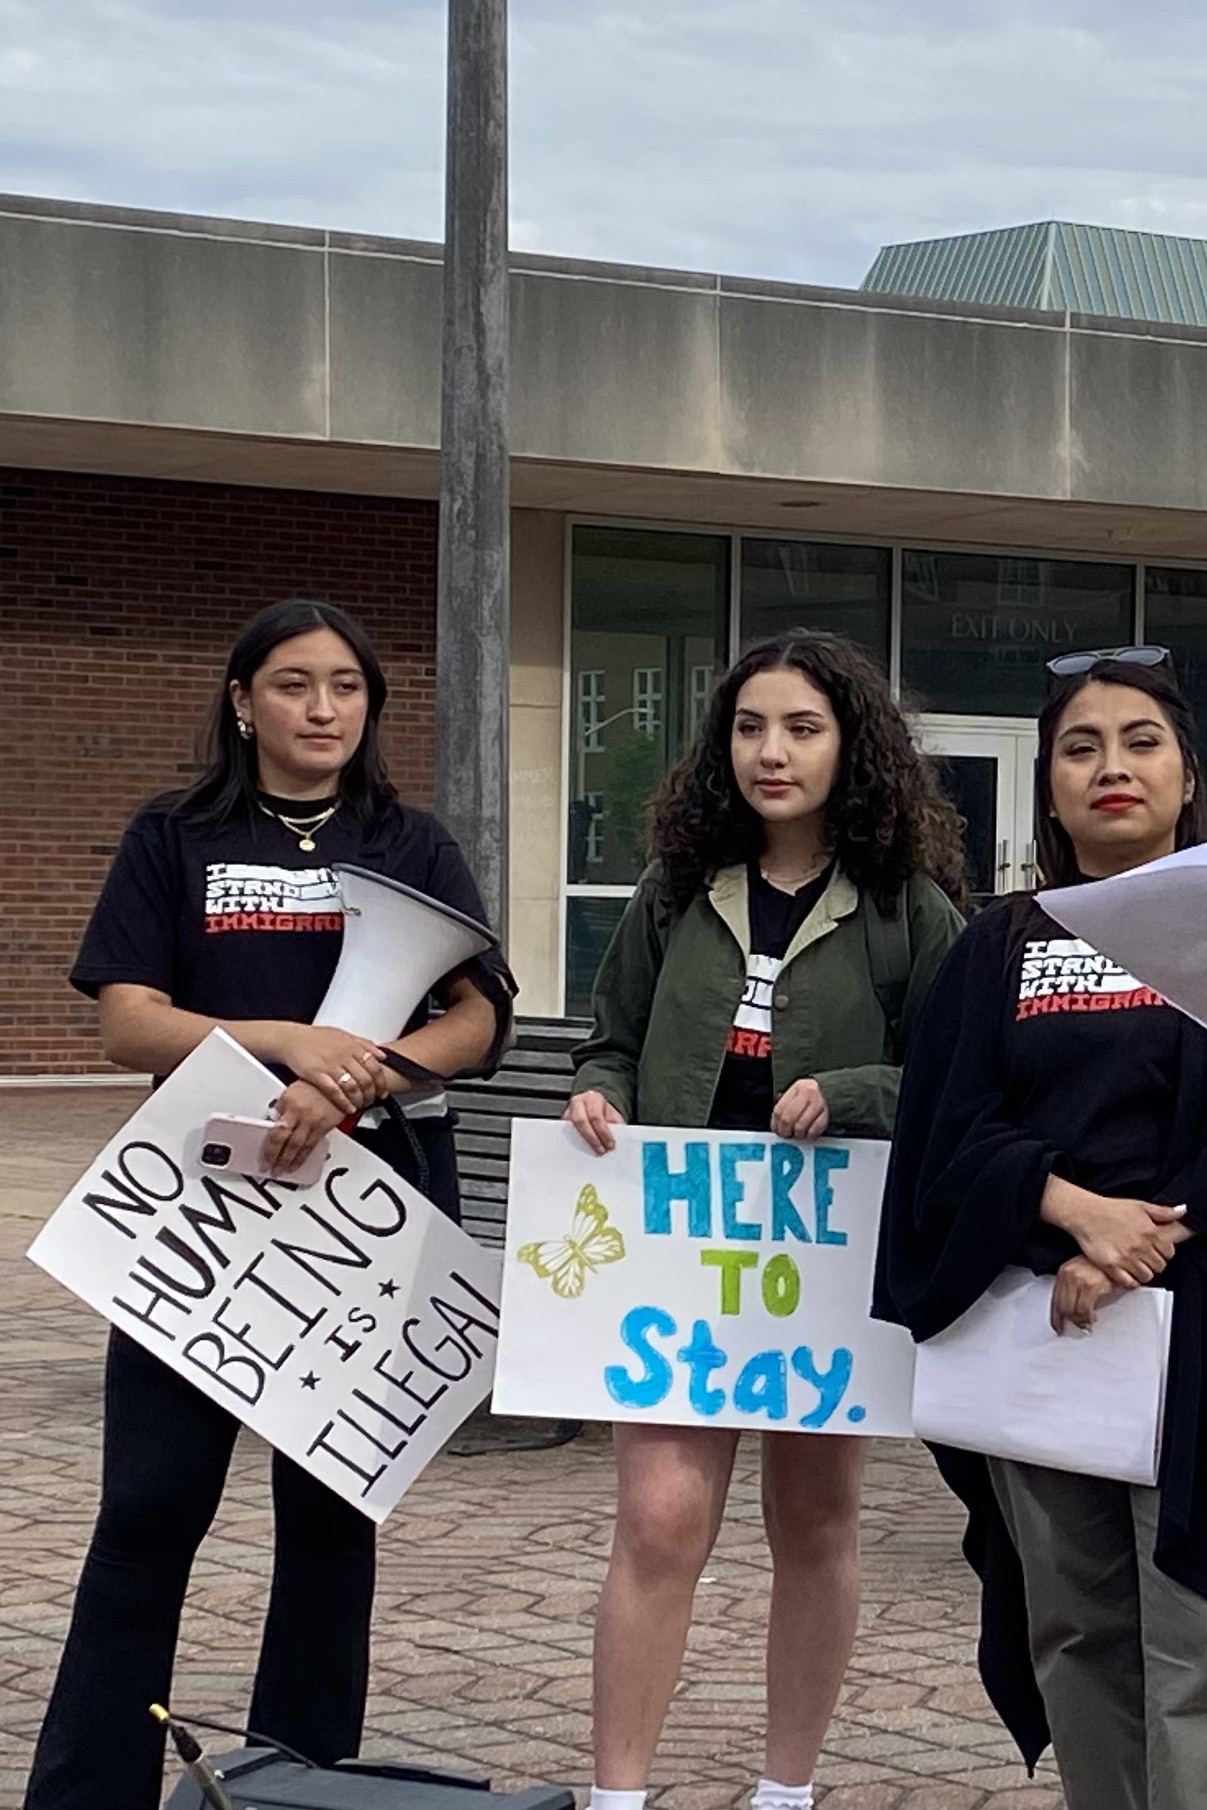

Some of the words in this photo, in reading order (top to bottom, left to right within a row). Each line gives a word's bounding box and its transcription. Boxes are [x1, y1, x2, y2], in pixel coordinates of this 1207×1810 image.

[952, 613, 1000, 639] EXIT
[1009, 617, 1078, 643] ONLY
[82, 1141, 185, 1239] NO
[641, 1141, 850, 1246] HERE
[182, 1167, 407, 1405] BEING
[700, 1249, 800, 1318] TO
[325, 1306, 377, 1362] IS
[604, 1305, 867, 1428] Stay.
